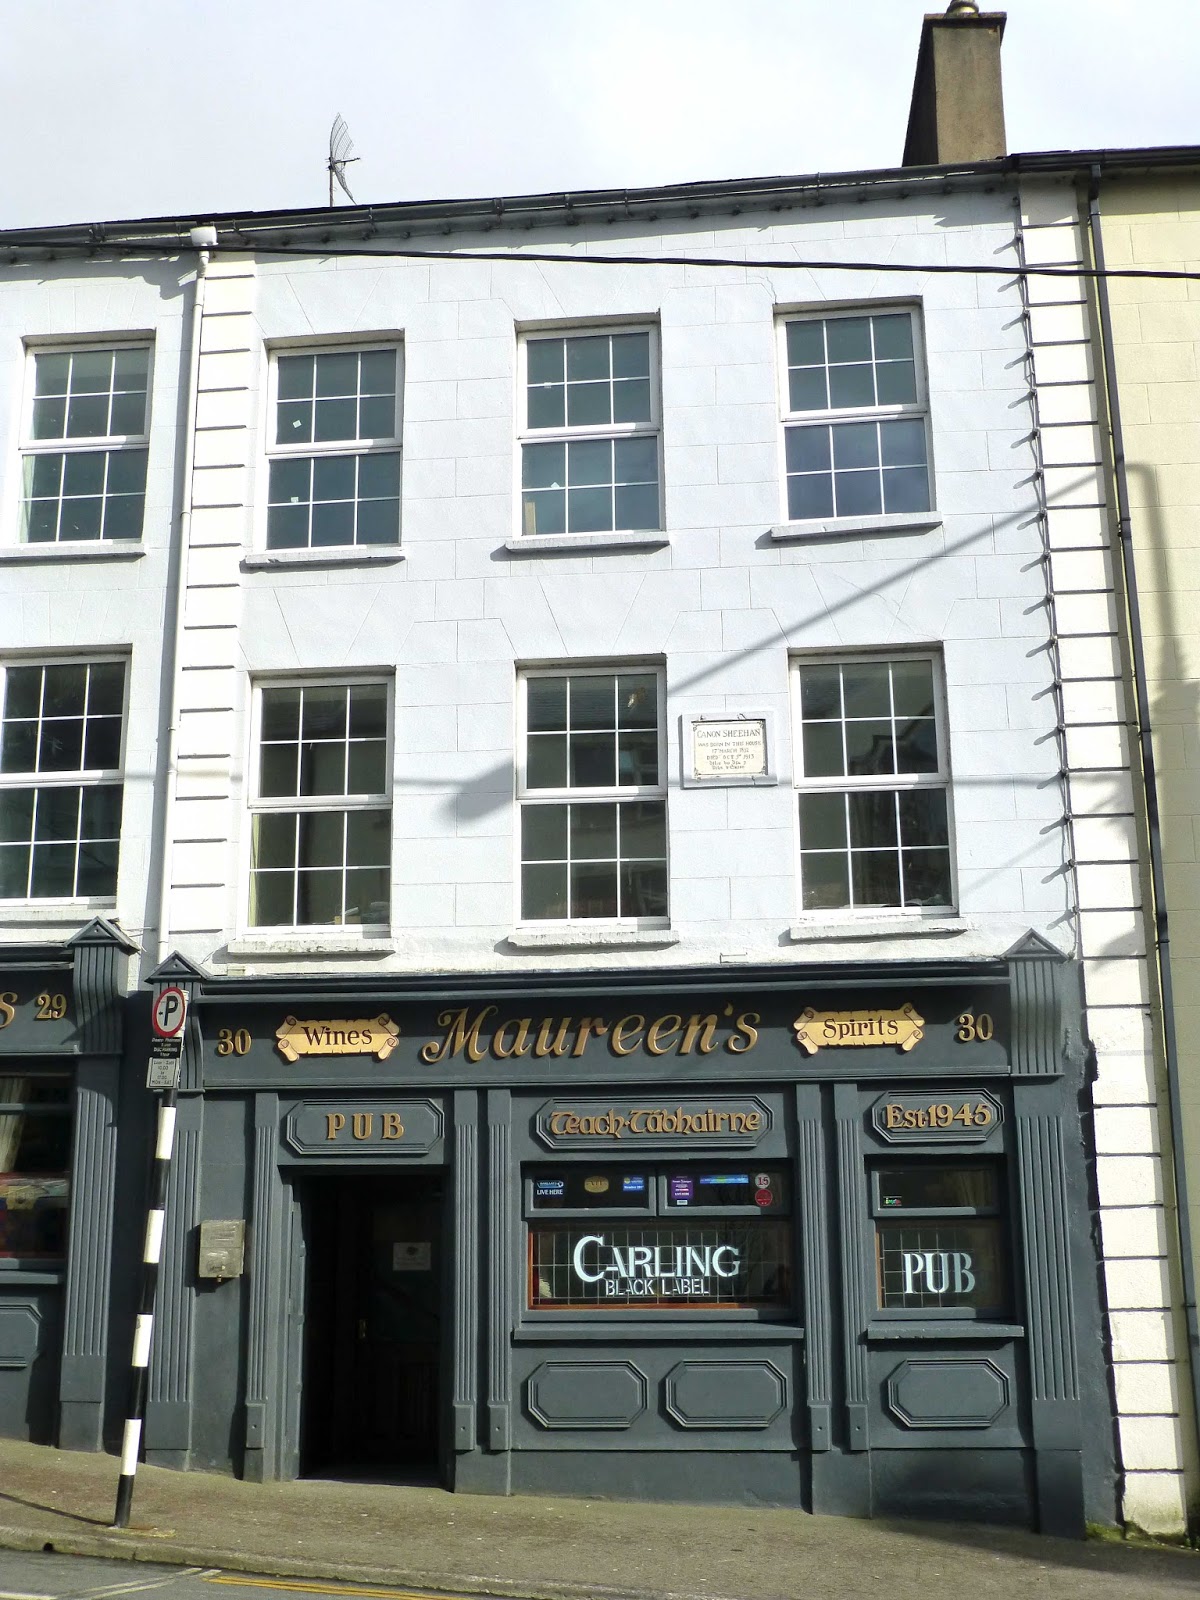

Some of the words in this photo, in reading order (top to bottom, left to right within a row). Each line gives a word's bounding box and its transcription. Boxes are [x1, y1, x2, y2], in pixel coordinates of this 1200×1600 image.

[697, 730, 721, 738] CANON
[723, 728, 761, 738] SHEEHAN
[36, 993, 67, 1019] 29
[301, 1025, 373, 1047] Wines
[421, 1002, 761, 1063] Maureen's
[822, 1018, 899, 1040] Spirits
[958, 1012, 994, 1042] 30
[217, 1028, 252, 1056] 30
[326, 1112, 405, 1141] PUB
[757, 1176, 769, 1186] 15
[573, 1235, 741, 1283] CARLING
[903, 1252, 976, 1294] PUB
[606, 1279, 654, 1296] BLACK
[662, 1278, 710, 1295] LABEL
